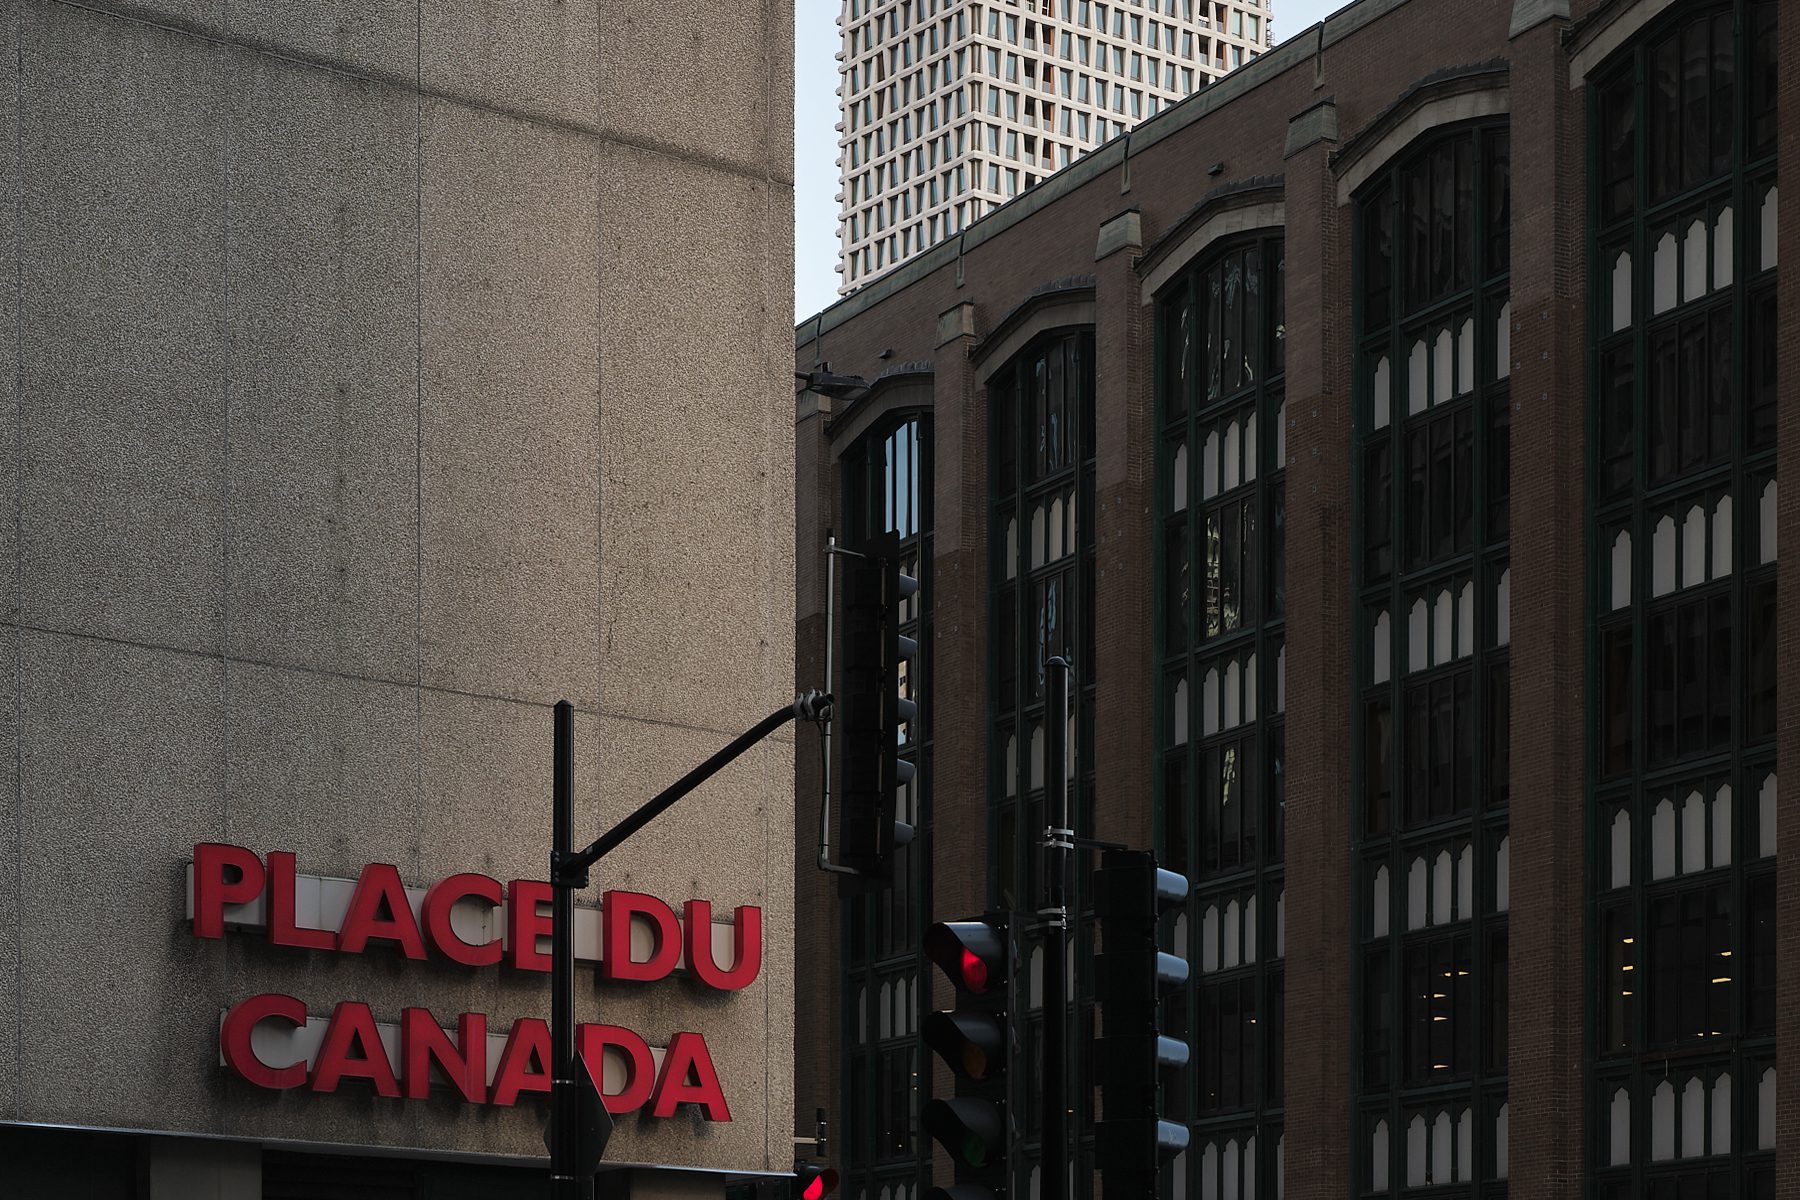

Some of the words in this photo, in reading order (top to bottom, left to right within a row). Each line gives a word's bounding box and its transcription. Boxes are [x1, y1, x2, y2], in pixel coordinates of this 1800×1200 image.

[193, 843, 553, 973] PLACE
[602, 889, 762, 991] DU
[221, 993, 732, 1123] CANADA
